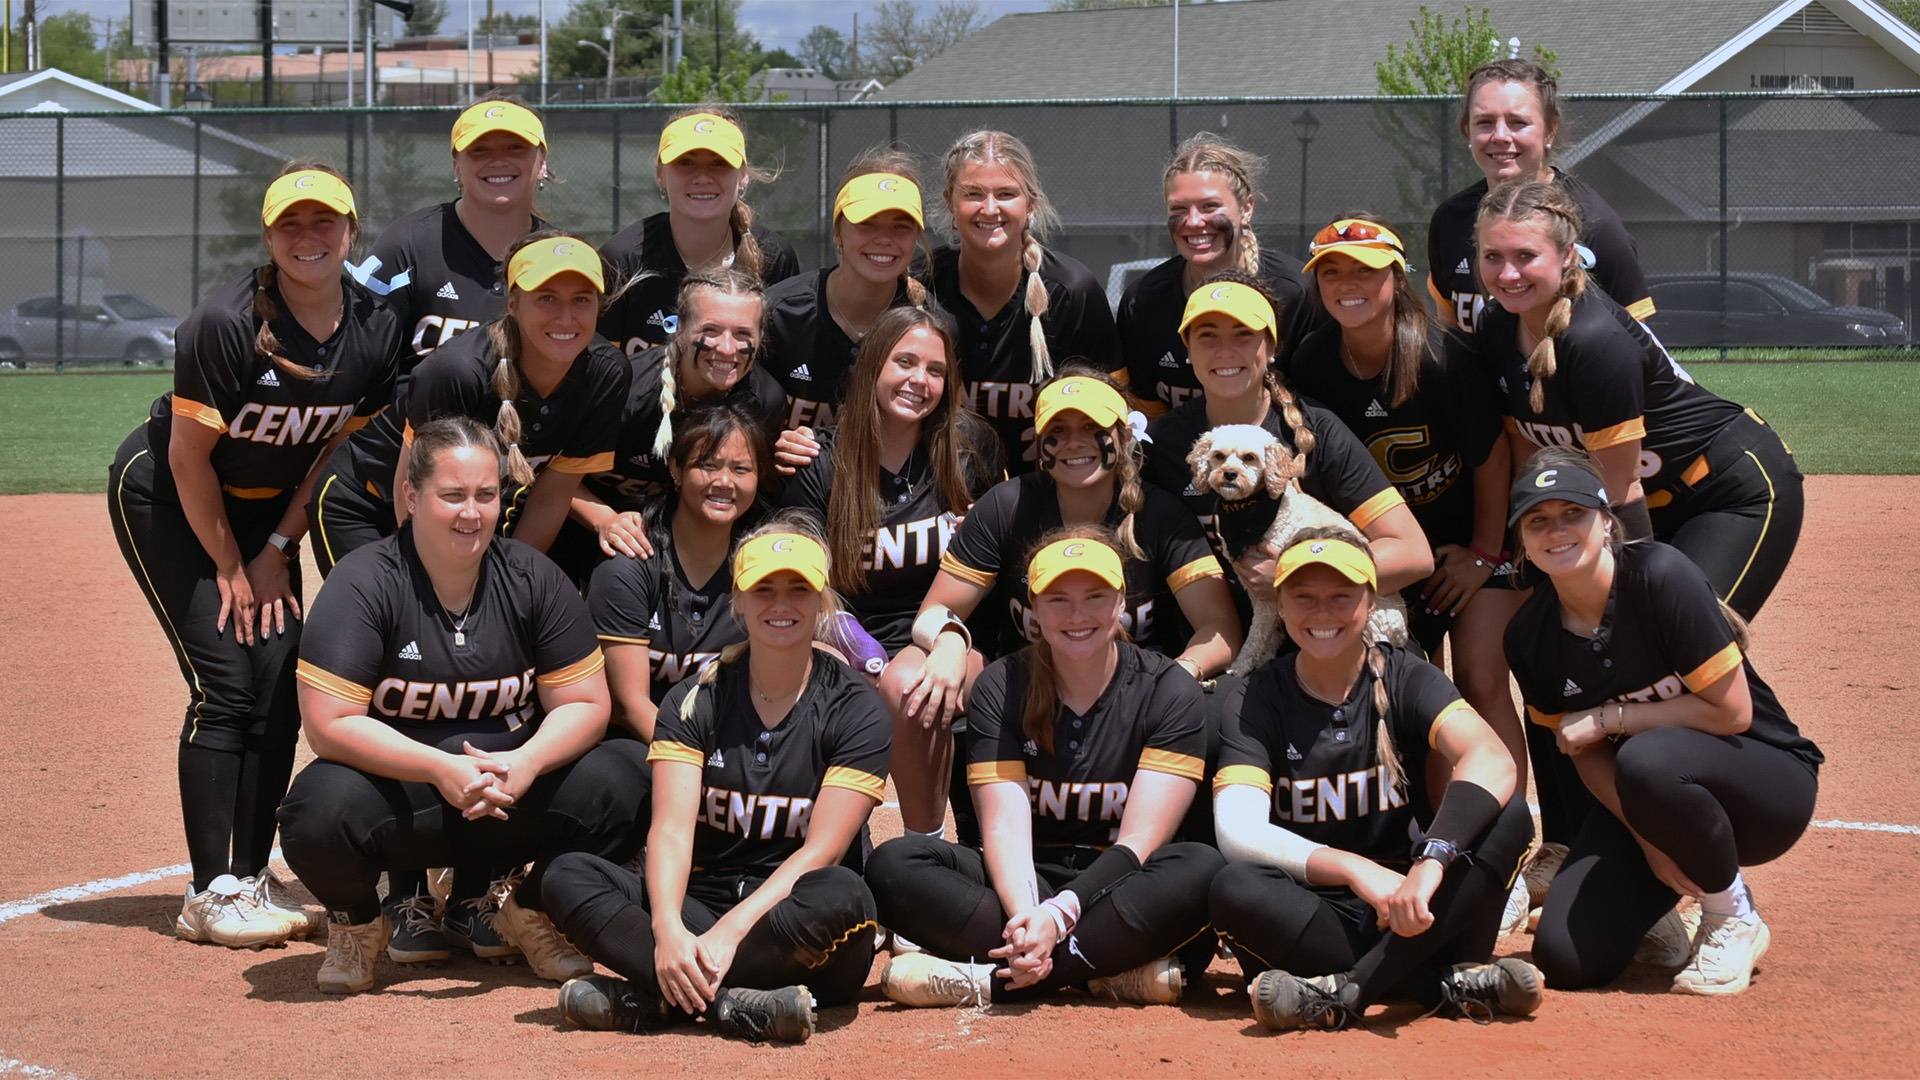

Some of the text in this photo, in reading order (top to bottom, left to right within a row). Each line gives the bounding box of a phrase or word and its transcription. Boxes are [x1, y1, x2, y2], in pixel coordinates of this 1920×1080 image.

[256, 378, 280, 387] adidas
[228, 400, 360, 446] CENTR
[1535, 469, 1557, 488] C
[771, 538, 794, 553] C
[398, 650, 422, 661] adidas
[1275, 765, 1408, 824] CENTR
[697, 786, 814, 839] ENTR
